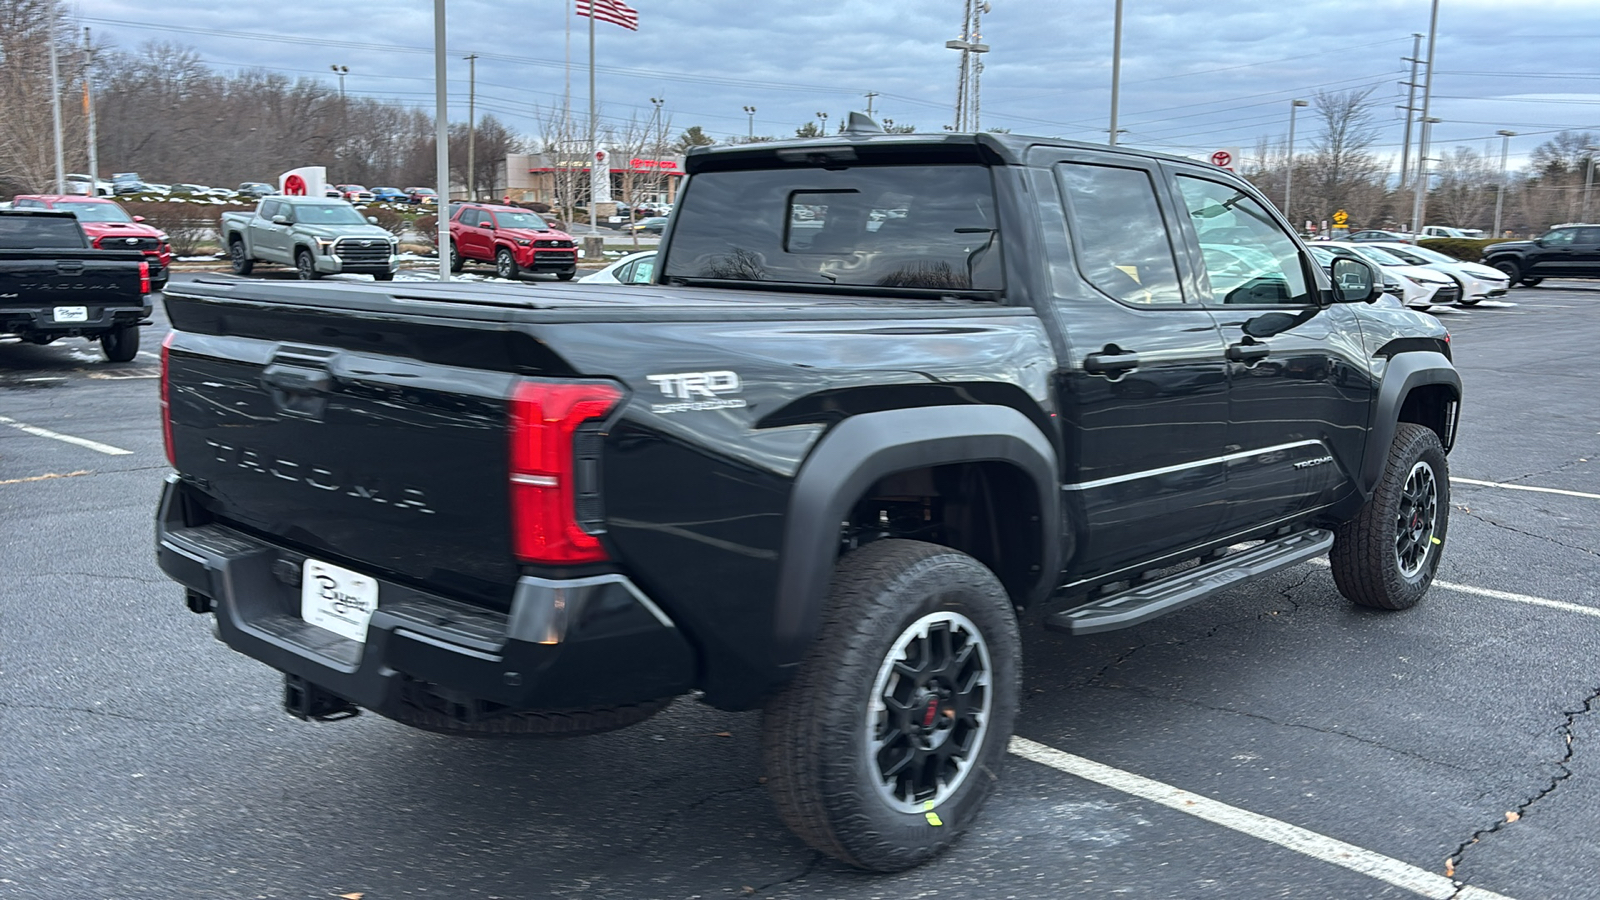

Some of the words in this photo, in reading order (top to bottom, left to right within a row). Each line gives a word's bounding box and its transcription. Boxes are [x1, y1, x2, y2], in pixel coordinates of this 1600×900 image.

[646, 370, 740, 399] TRD
[206, 438, 436, 515] TACOMA
[1293, 456, 1333, 469] TACOMA
